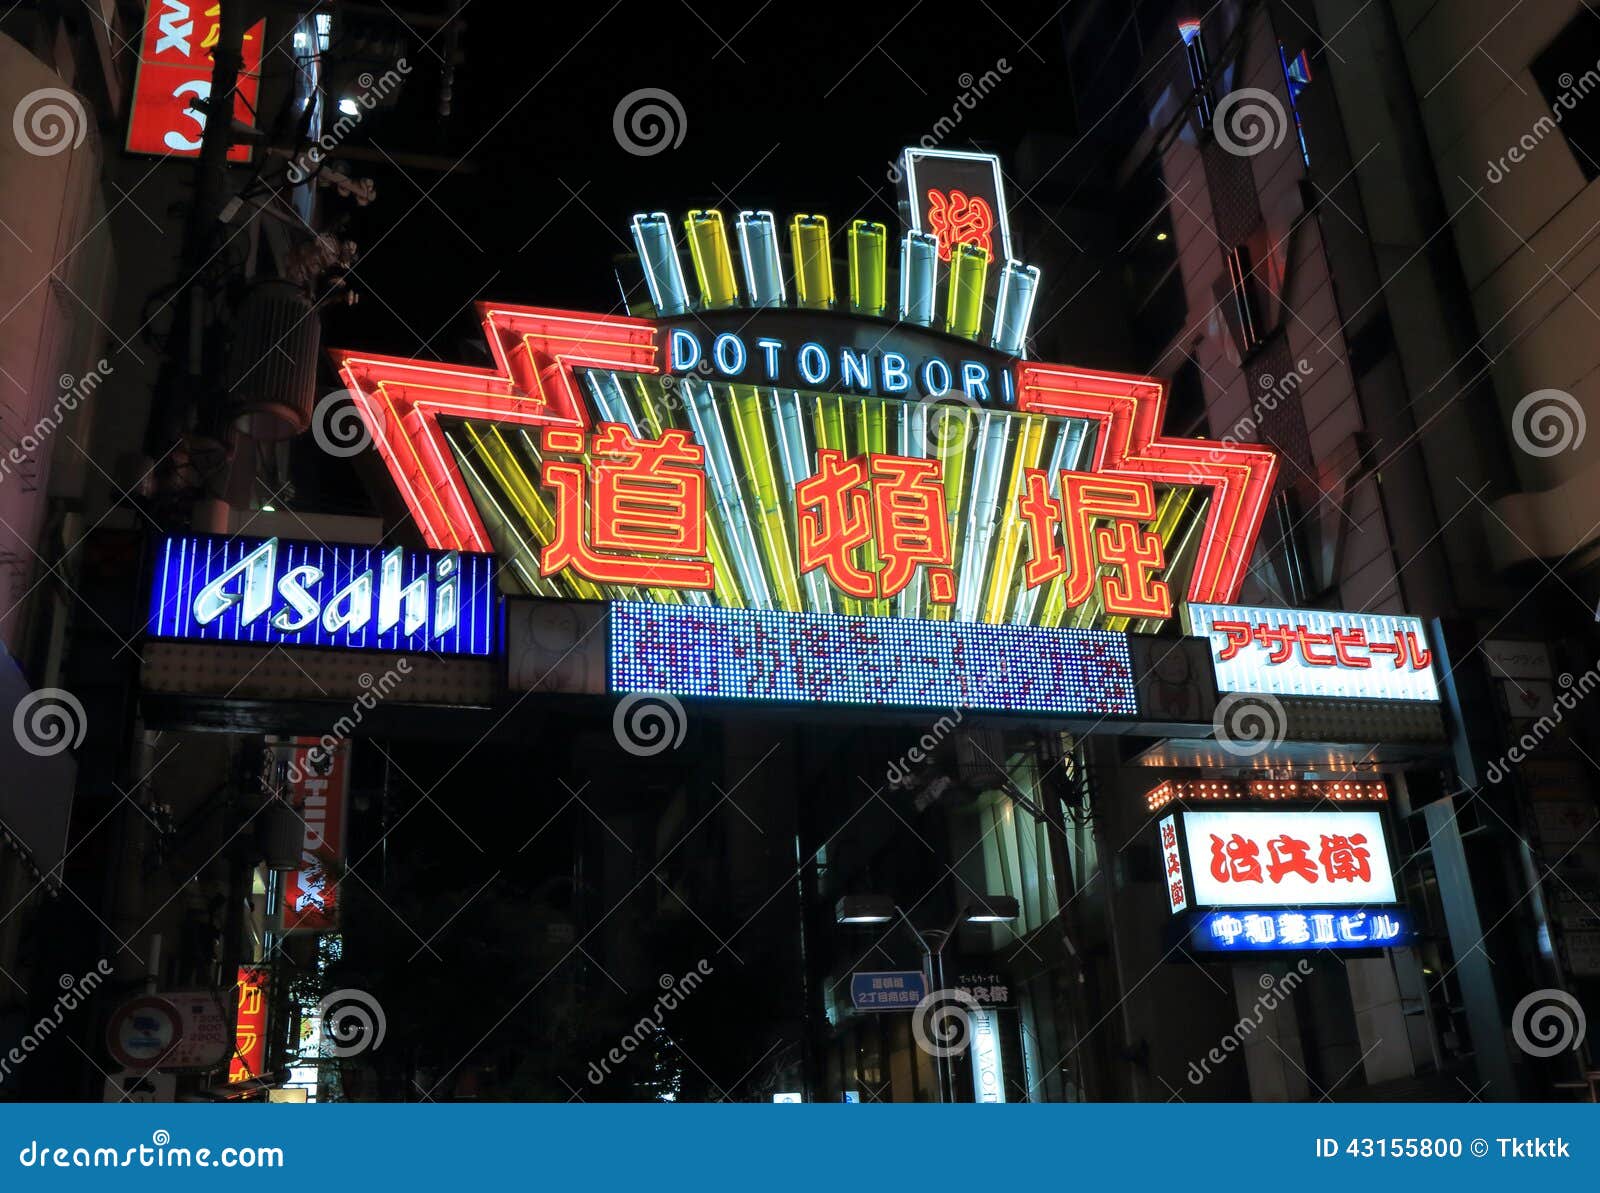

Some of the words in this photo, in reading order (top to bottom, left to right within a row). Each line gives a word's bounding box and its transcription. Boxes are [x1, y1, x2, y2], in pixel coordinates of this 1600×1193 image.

[670, 328, 1015, 402] DOTONBORI
[540, 421, 1173, 619] 道頓堀
[193, 536, 458, 638] Asahi
[1212, 620, 1433, 670] アサヒビール
[1209, 833, 1371, 884] 治兵衛
